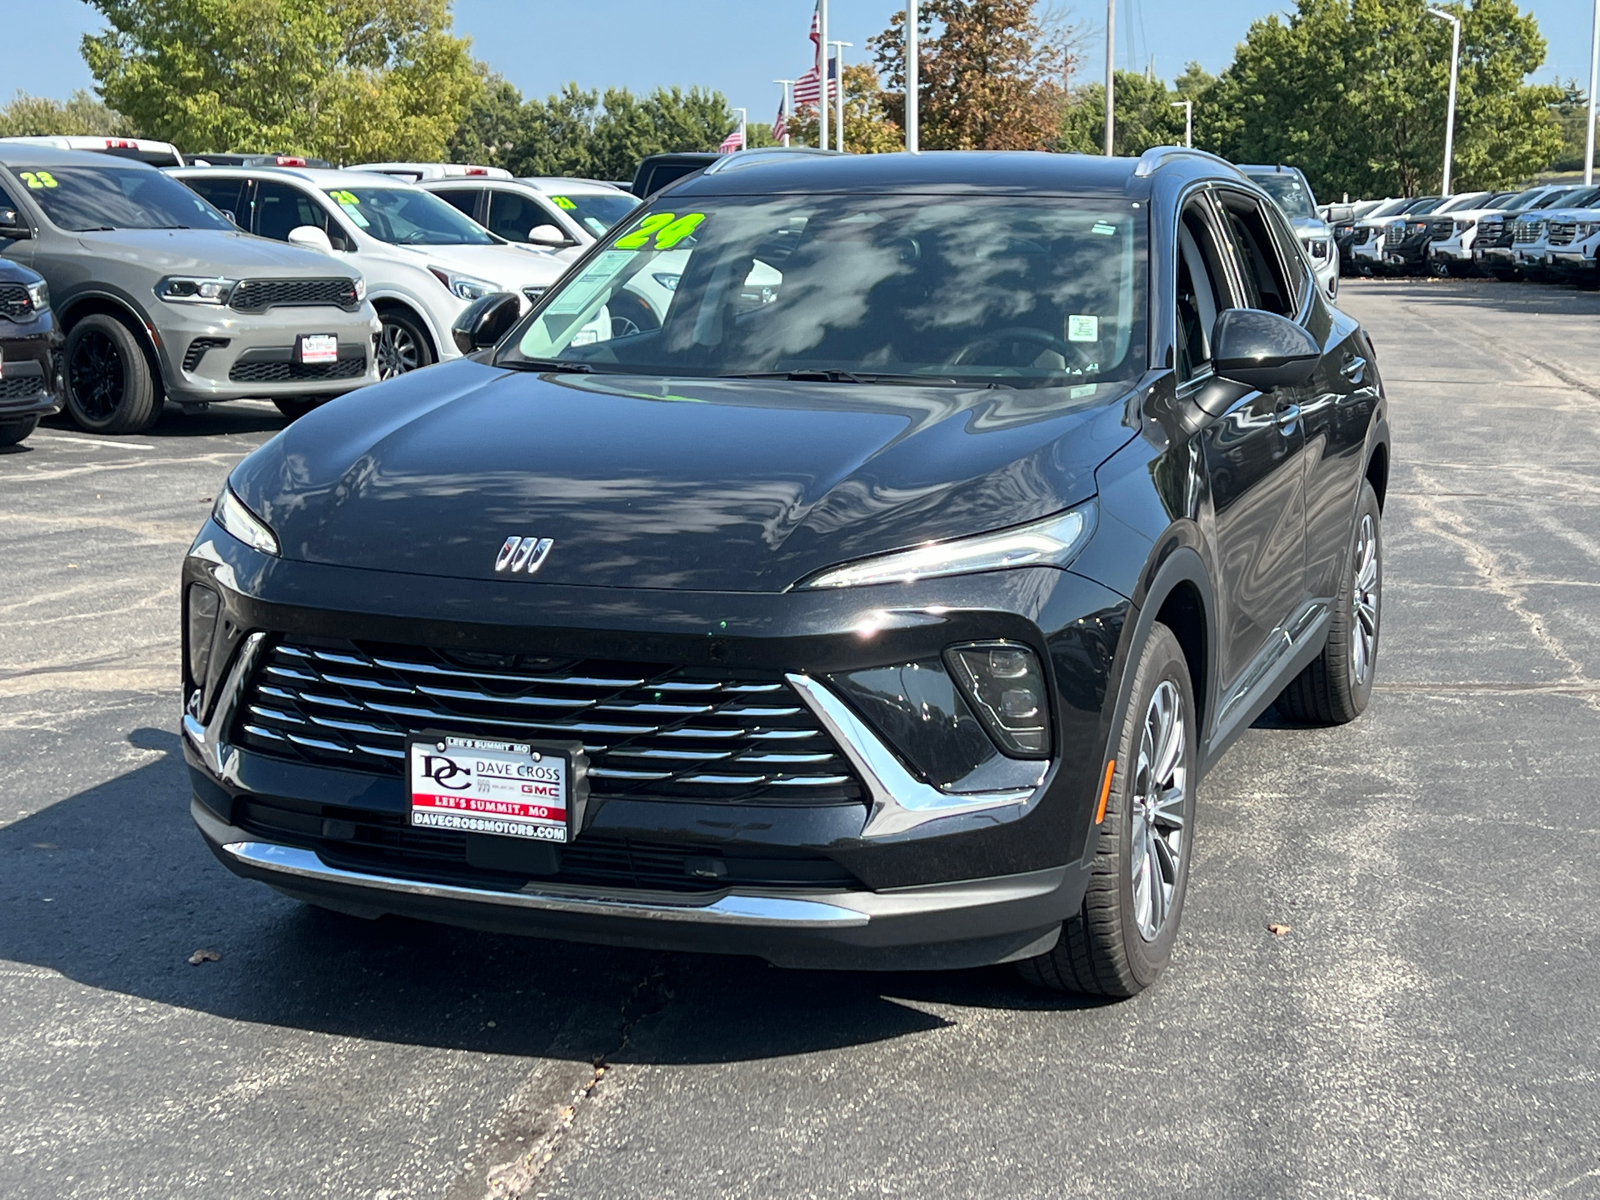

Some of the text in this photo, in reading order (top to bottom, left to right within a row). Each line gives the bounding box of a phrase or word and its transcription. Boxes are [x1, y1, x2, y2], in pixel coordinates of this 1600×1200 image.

[20, 171, 58, 189] 23
[329, 190, 360, 205] 20
[551, 196, 578, 210] 21
[613, 212, 706, 250] 24
[474, 740, 509, 751] SUMMIT
[476, 761, 561, 781] DAVE CROSS
[521, 784, 560, 798] GMC
[435, 796, 549, 817] LEE'S SUMMIT, MO
[414, 813, 565, 841] DAVECROSSMOTORS.COM
